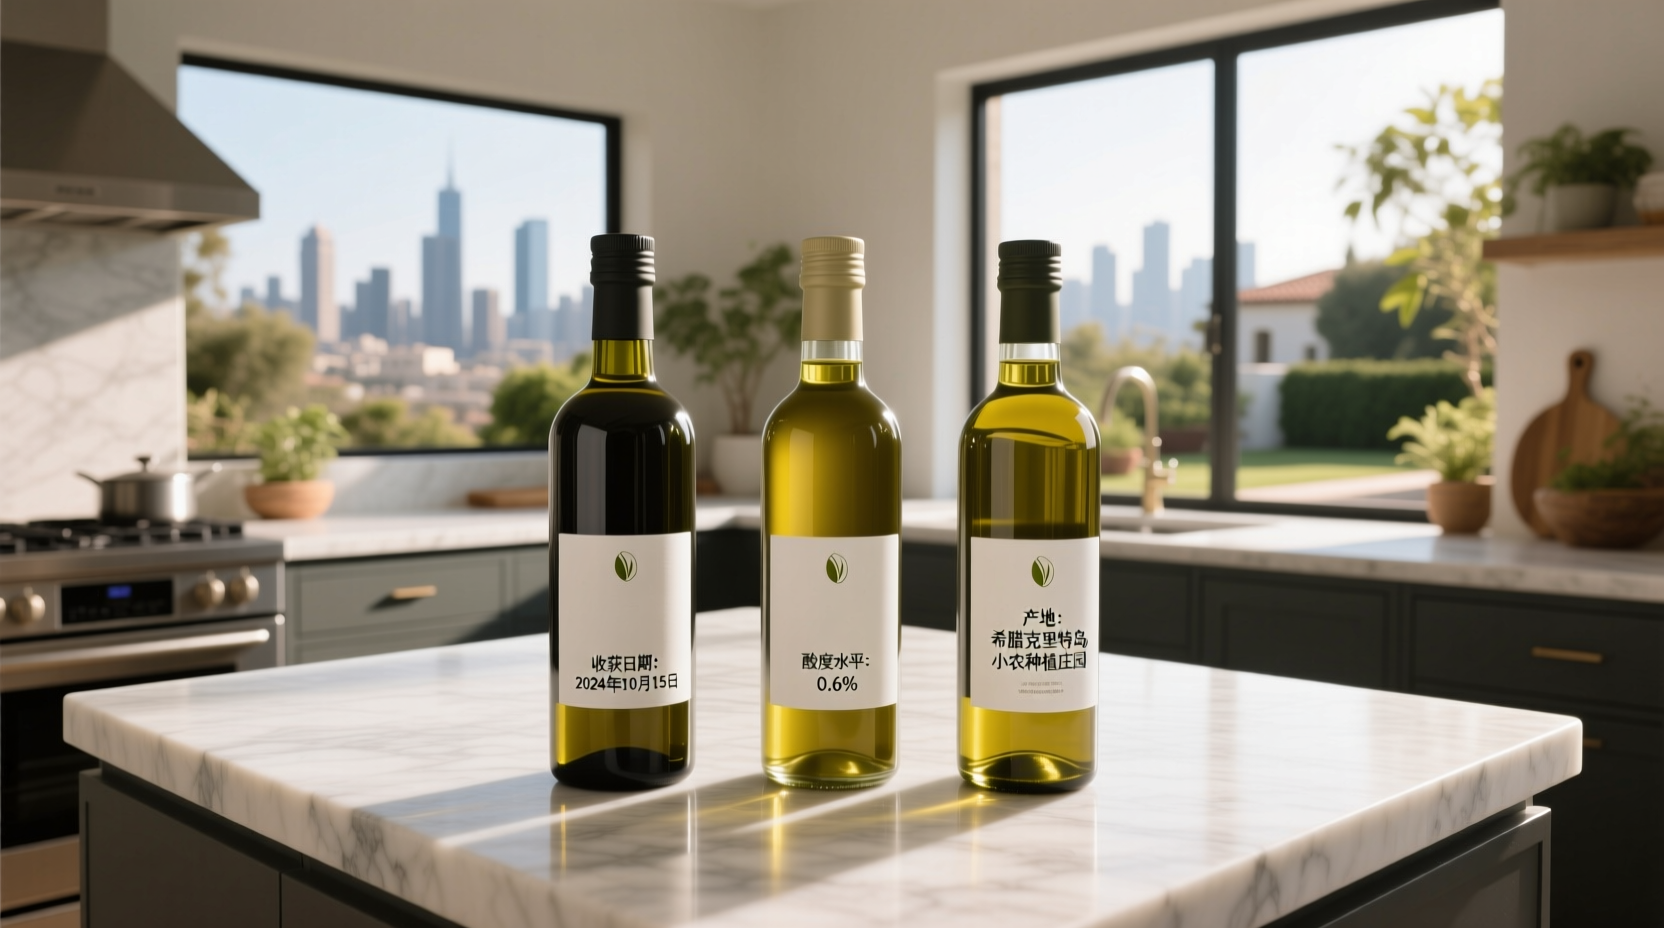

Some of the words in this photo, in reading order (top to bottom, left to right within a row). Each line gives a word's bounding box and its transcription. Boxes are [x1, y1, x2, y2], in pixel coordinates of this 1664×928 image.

[1023, 607, 1061, 627] 产地：
[575, 673, 677, 693] 2024年10月15日
[817, 675, 857, 692] 0.6%
